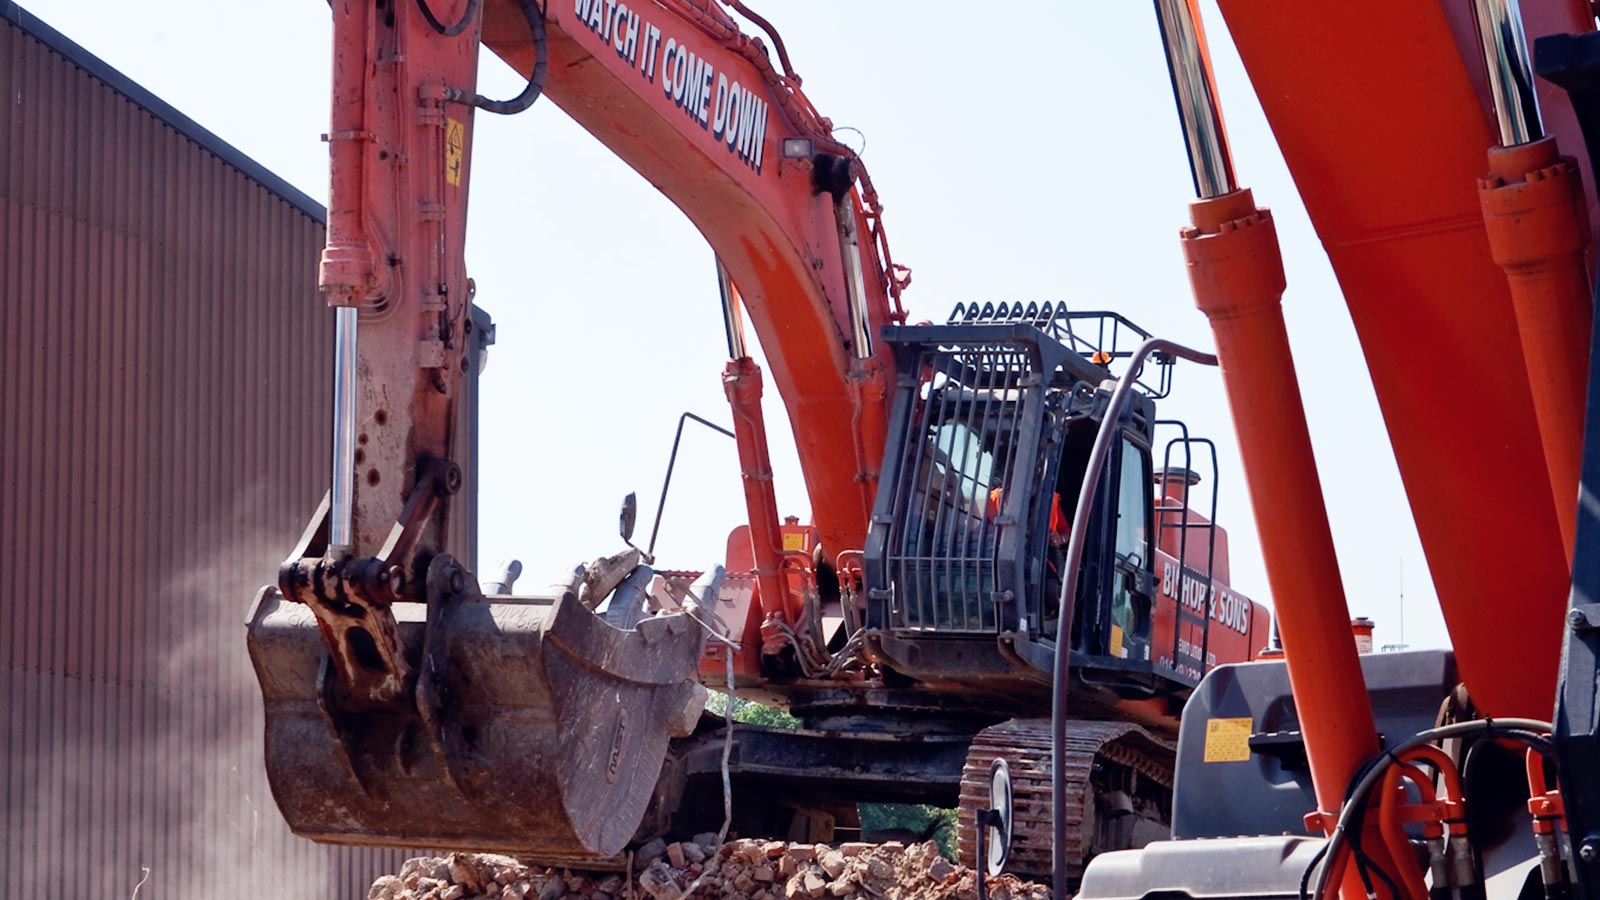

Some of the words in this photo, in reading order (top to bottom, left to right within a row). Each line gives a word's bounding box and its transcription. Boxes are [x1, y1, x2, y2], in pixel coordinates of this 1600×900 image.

[641, 21, 661, 81] IT
[662, 37, 713, 127] COME
[713, 72, 768, 171] DOWN
[1209, 585, 1216, 618] &
[1219, 591, 1248, 634] SONS
